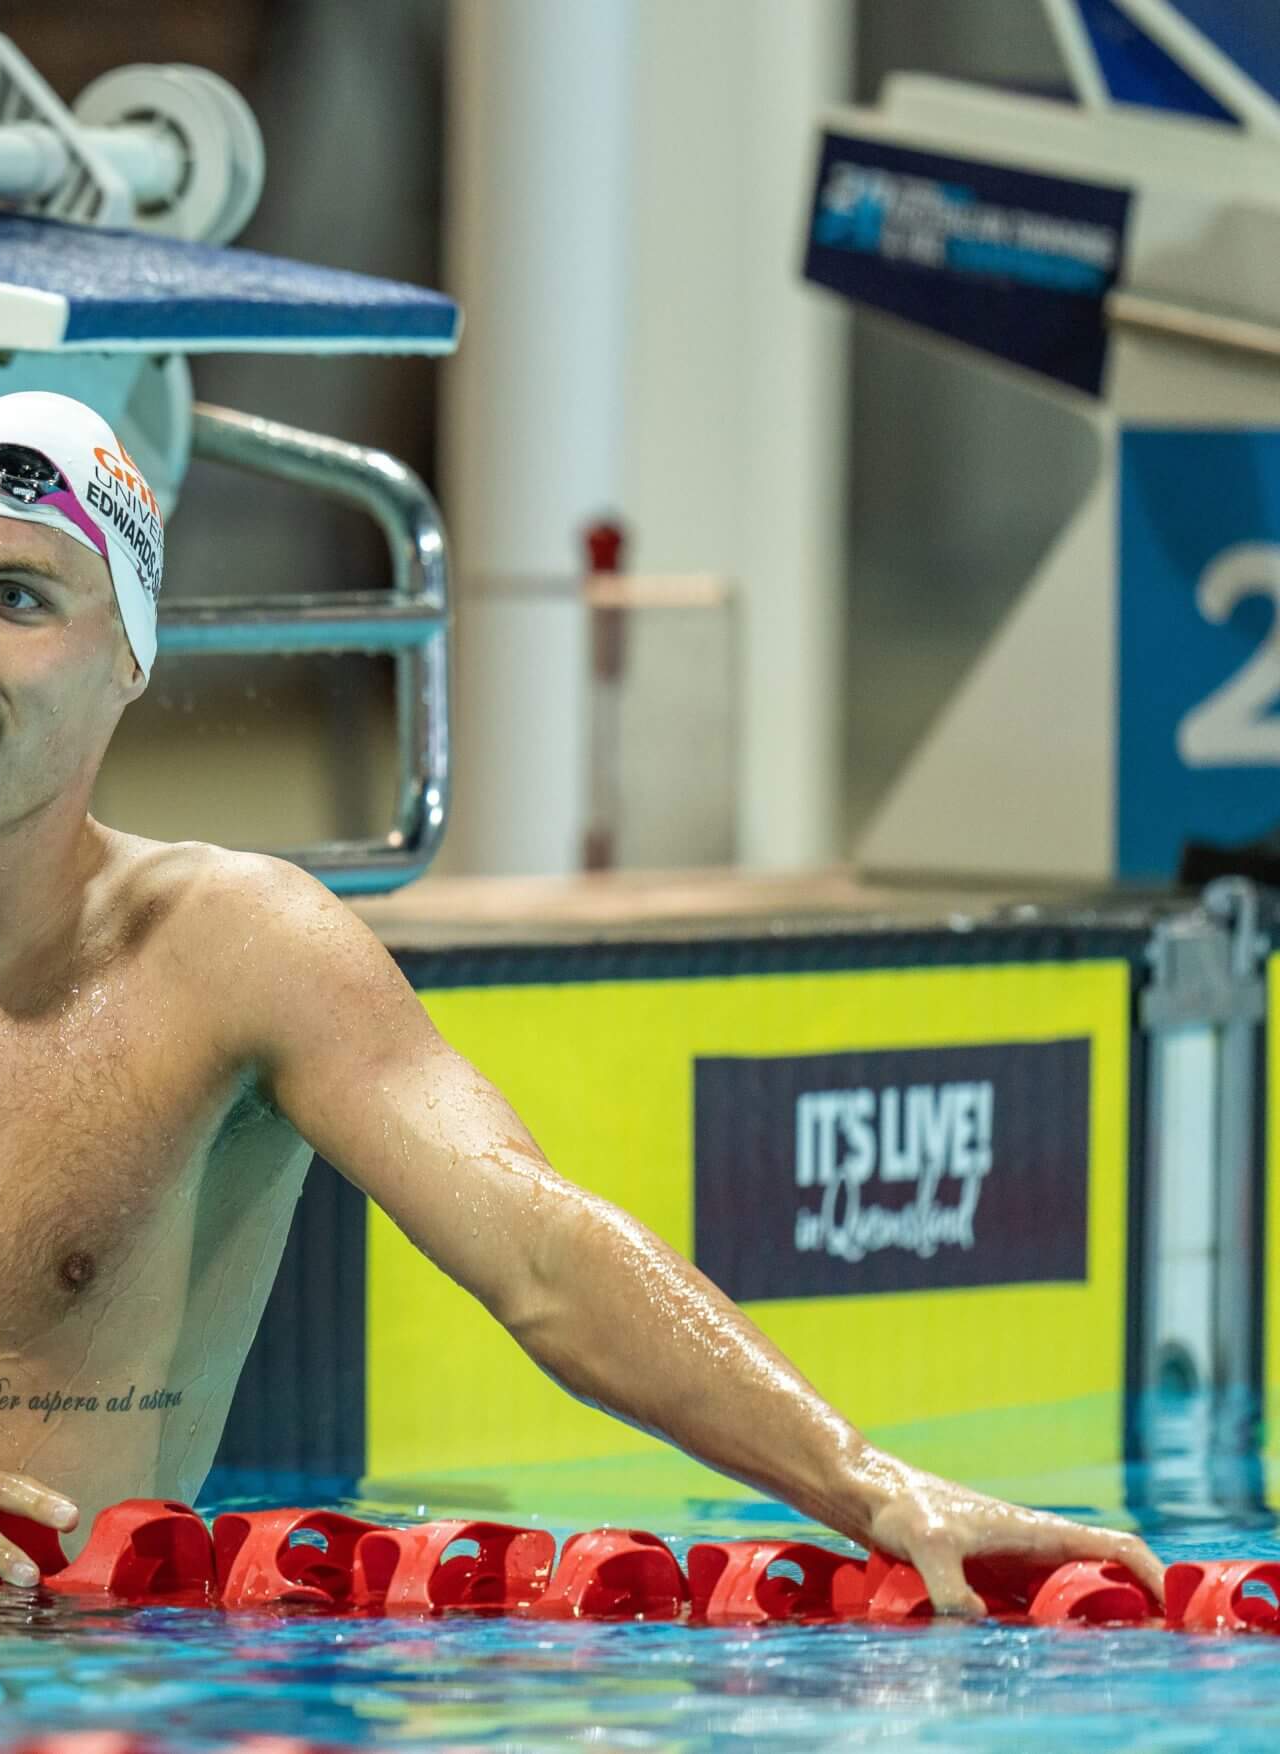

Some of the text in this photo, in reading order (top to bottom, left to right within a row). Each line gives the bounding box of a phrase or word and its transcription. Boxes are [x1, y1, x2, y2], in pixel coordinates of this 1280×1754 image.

[1176, 540, 1280, 768] 2
[794, 1080, 995, 1188] IT'S LIVE!
[821, 1162, 981, 1264] Queensland
[28, 1391, 99, 1423] aspera
[106, 1386, 136, 1412] ad
[139, 1388, 183, 1410] astra
